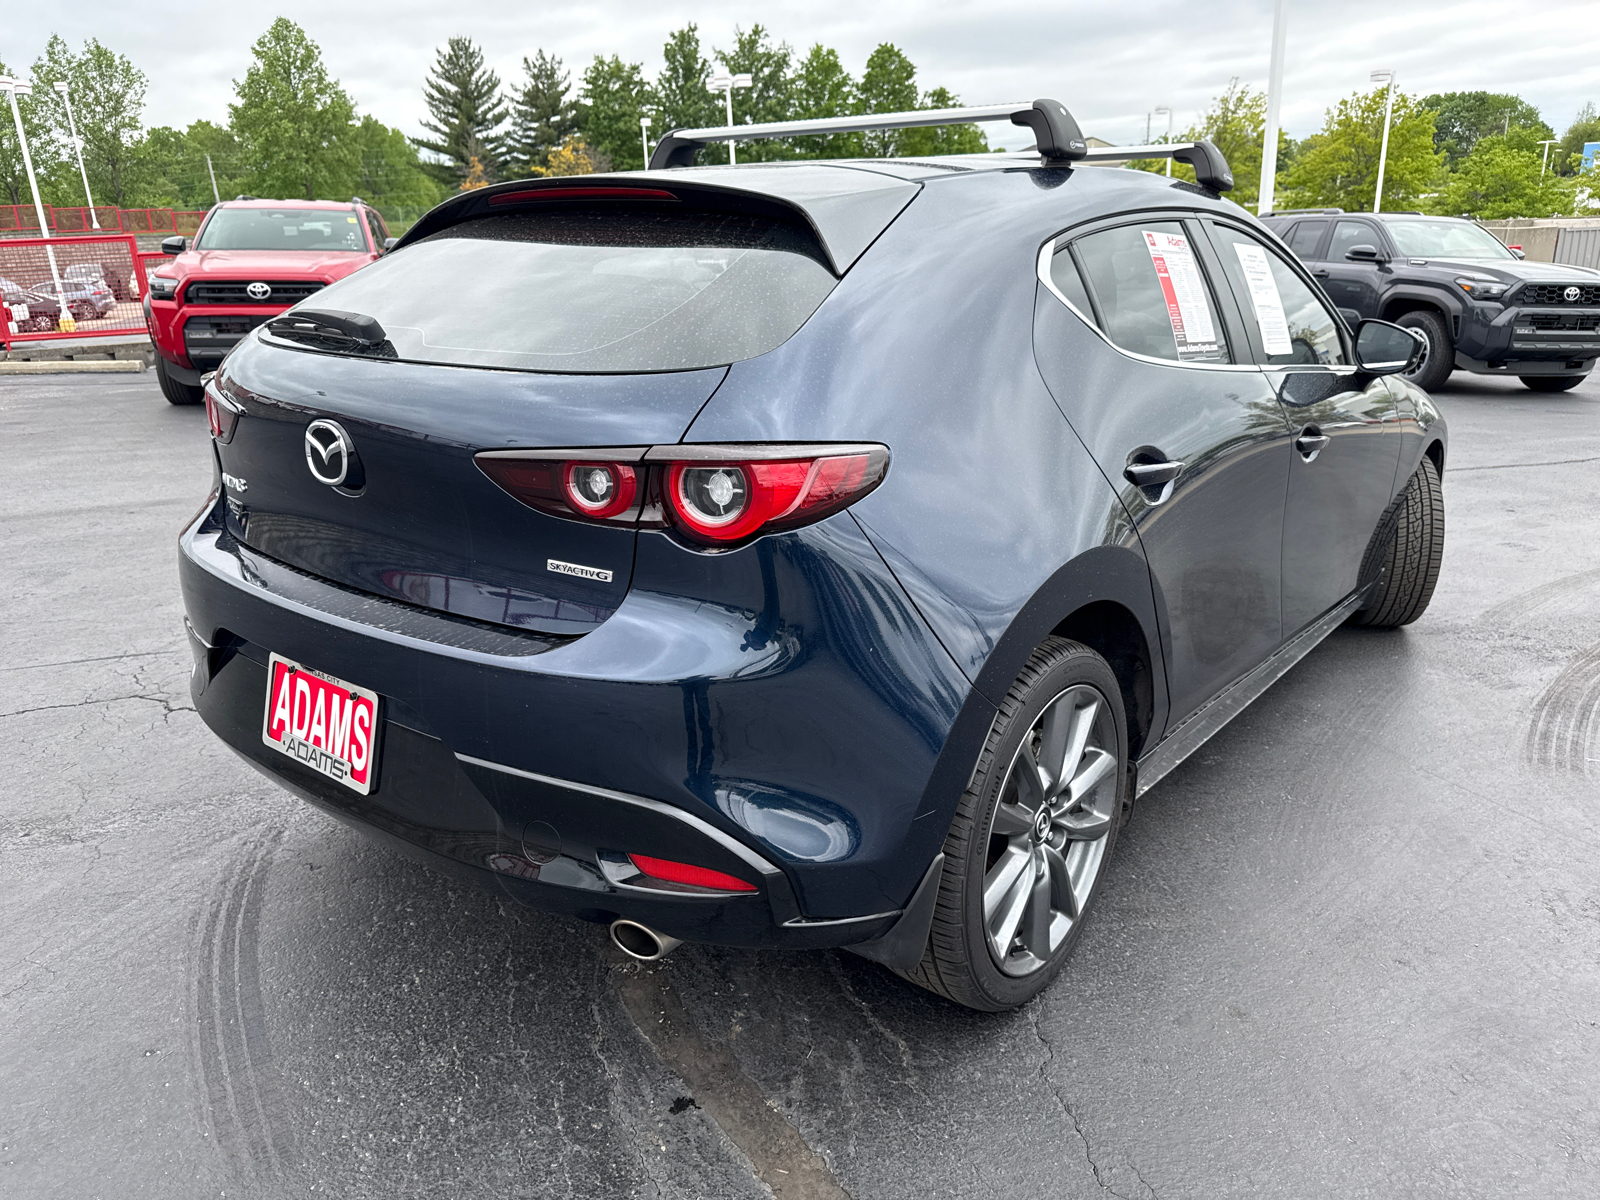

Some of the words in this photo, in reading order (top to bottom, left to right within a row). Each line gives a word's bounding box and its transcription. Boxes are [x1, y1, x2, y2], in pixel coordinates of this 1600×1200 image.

[326, 675, 340, 685] CITY
[272, 672, 370, 771] ADAMS
[285, 738, 345, 780] ADAMS
[976, 775, 1002, 855] Continental
